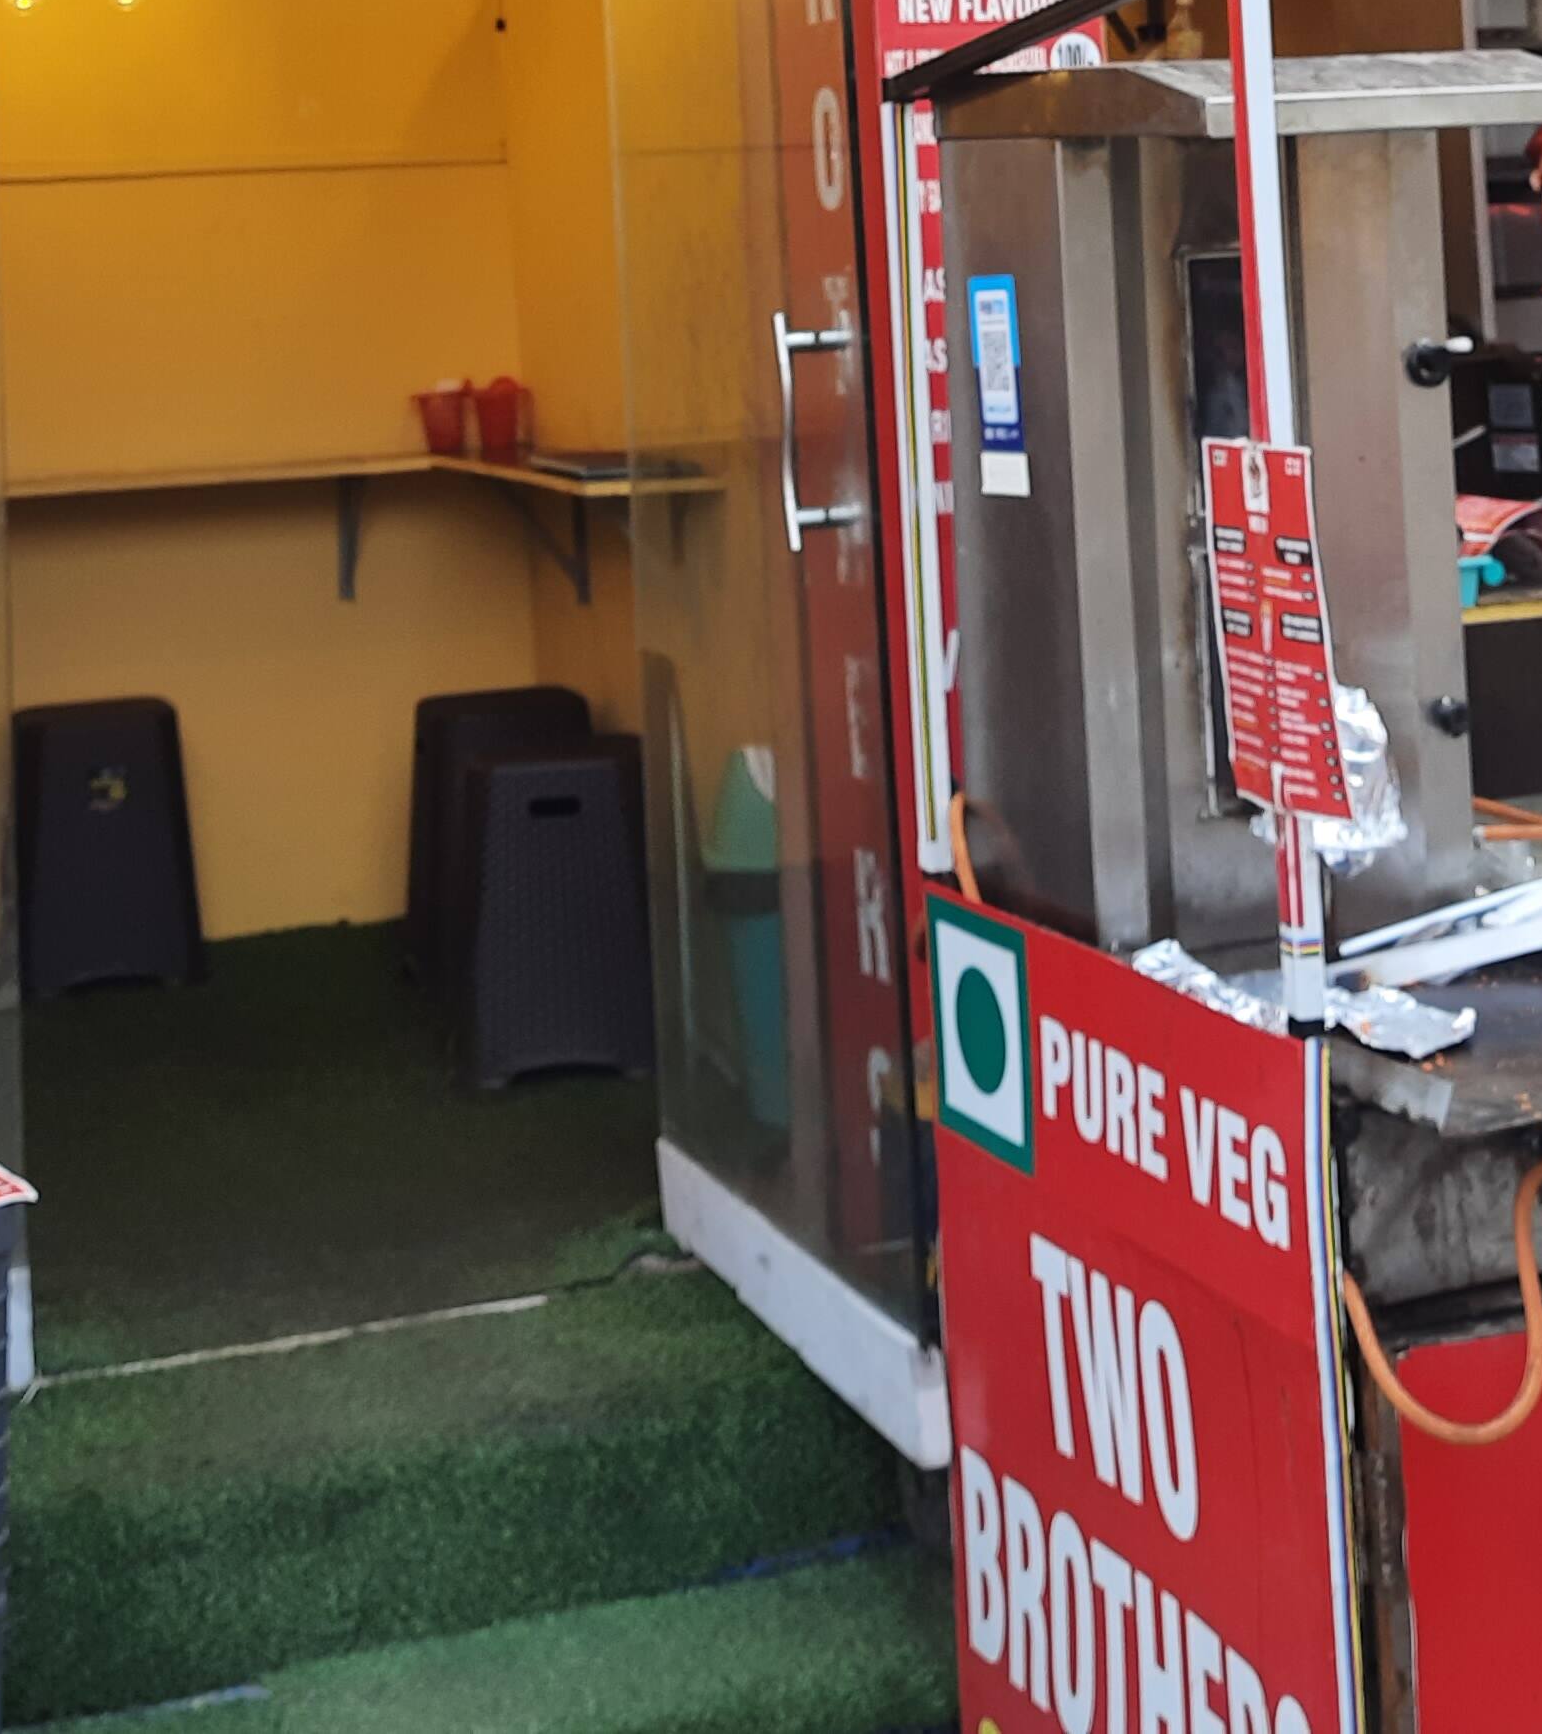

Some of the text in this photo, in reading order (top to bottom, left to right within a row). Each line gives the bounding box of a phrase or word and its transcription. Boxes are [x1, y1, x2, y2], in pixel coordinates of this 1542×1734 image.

[1039, 1014, 1293, 1252] PURE VEG
[1028, 1232, 1200, 1543] TWO
[960, 1444, 1314, 1734] BROTHE
